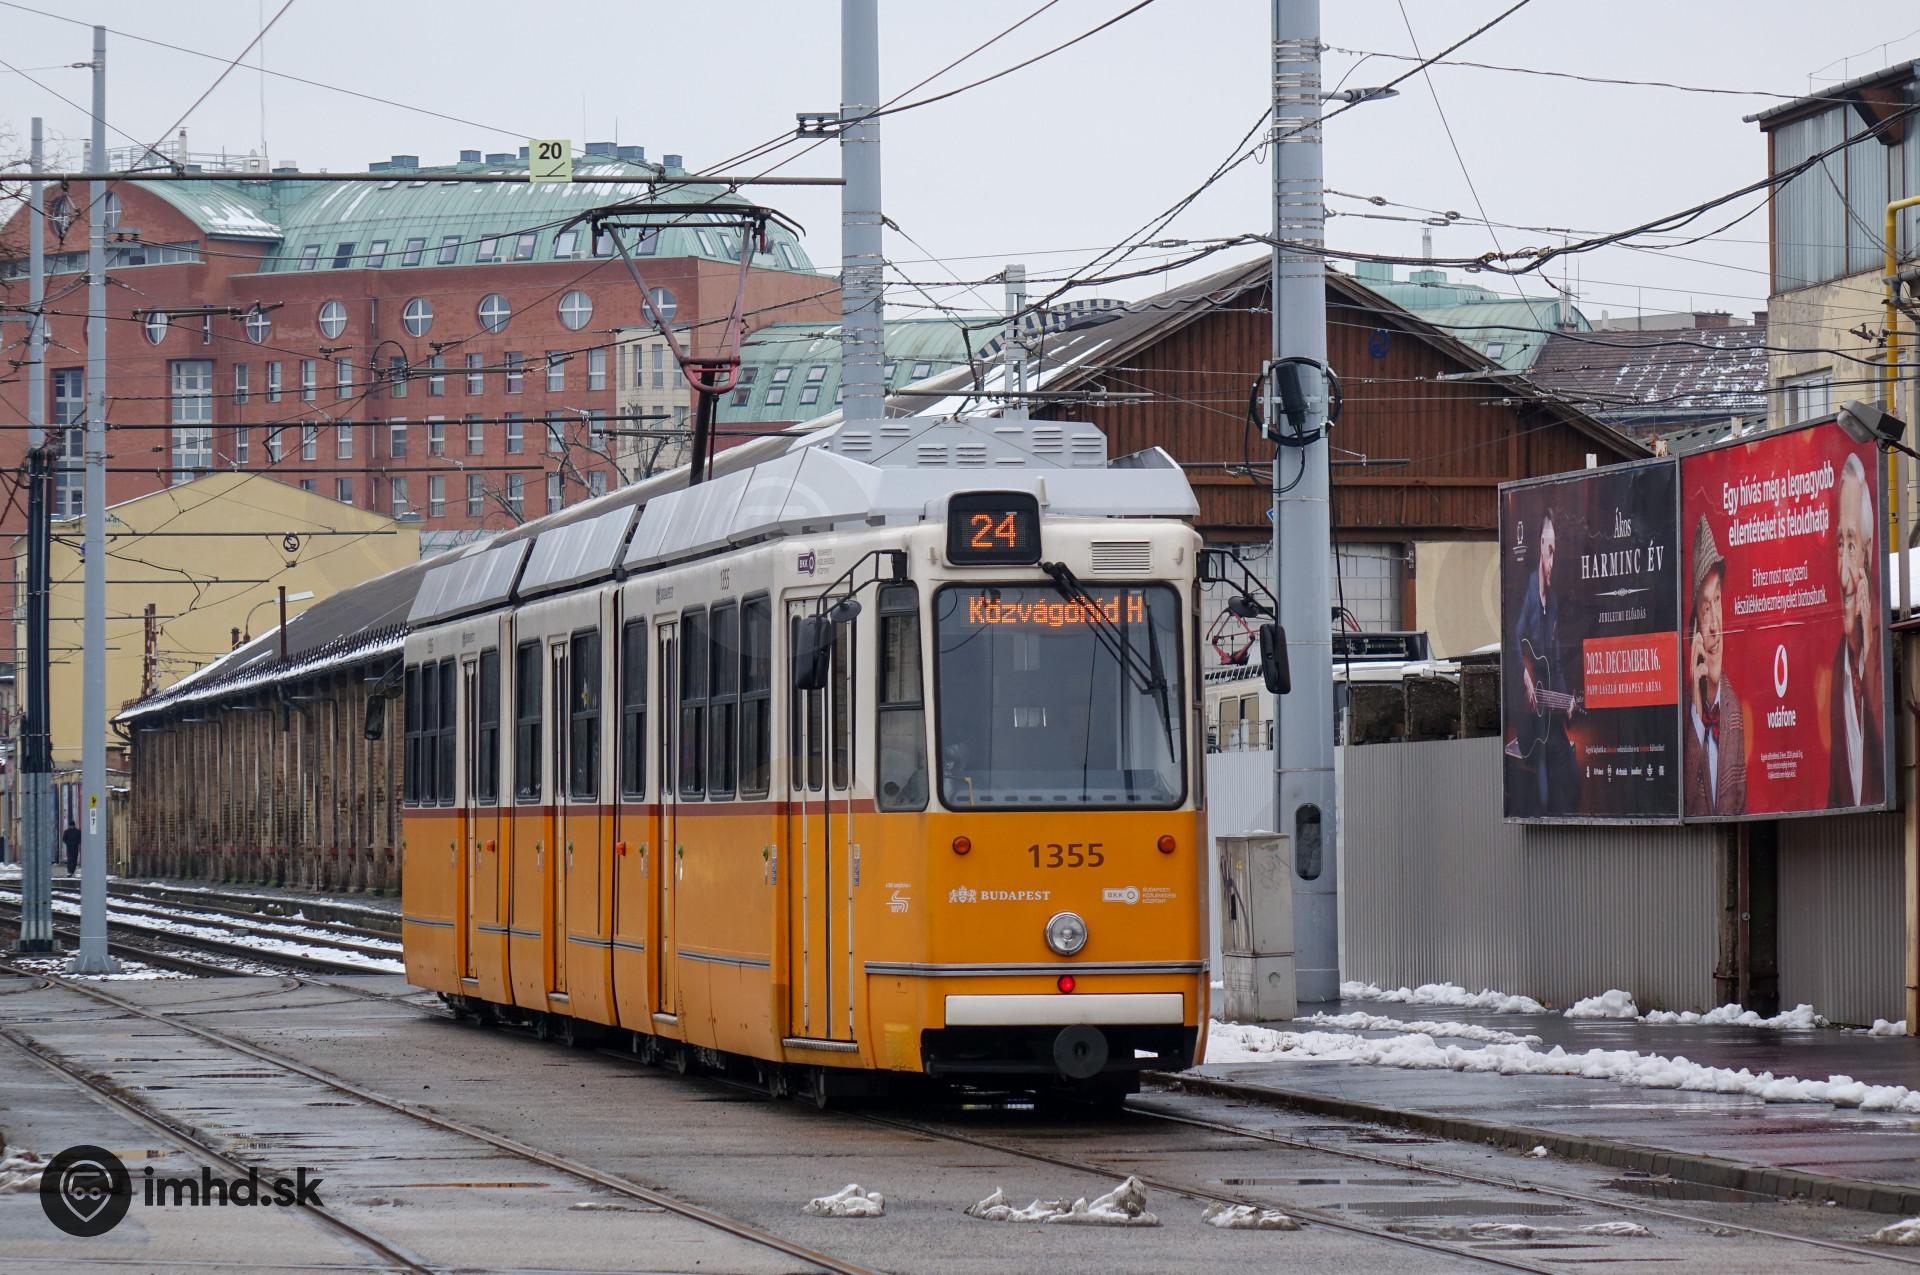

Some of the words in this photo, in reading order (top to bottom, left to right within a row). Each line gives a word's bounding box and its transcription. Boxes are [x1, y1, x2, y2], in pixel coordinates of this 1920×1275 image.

[538, 142, 562, 159] 20
[1723, 482, 1738, 515] Egy
[1740, 474, 1761, 506] hívás
[1763, 471, 1780, 507] még
[1781, 477, 1786, 498] a
[1788, 460, 1834, 503] legnagyobb
[971, 513, 1017, 548] 24
[1614, 507, 1631, 538] Ákos
[1728, 513, 1777, 547] ellentéteket
[1778, 511, 1786, 538] is
[1787, 503, 1829, 538] feloldhatja
[1581, 548, 1641, 579] HARMINC
[1647, 540, 1664, 572] ÉV
[720, 568, 730, 591] 1355
[1769, 566, 1782, 585] most
[969, 596, 1119, 627] Közvágóhíd
[1127, 596, 1143, 624] H
[1586, 651, 1605, 675] 2023.
[1605, 648, 1649, 674] DECEMBER
[1651, 648, 1661, 671] 16.
[1767, 705, 1797, 728] vodafone
[1028, 843, 1105, 869] 1355
[980, 890, 1051, 901] BUDAPEST
